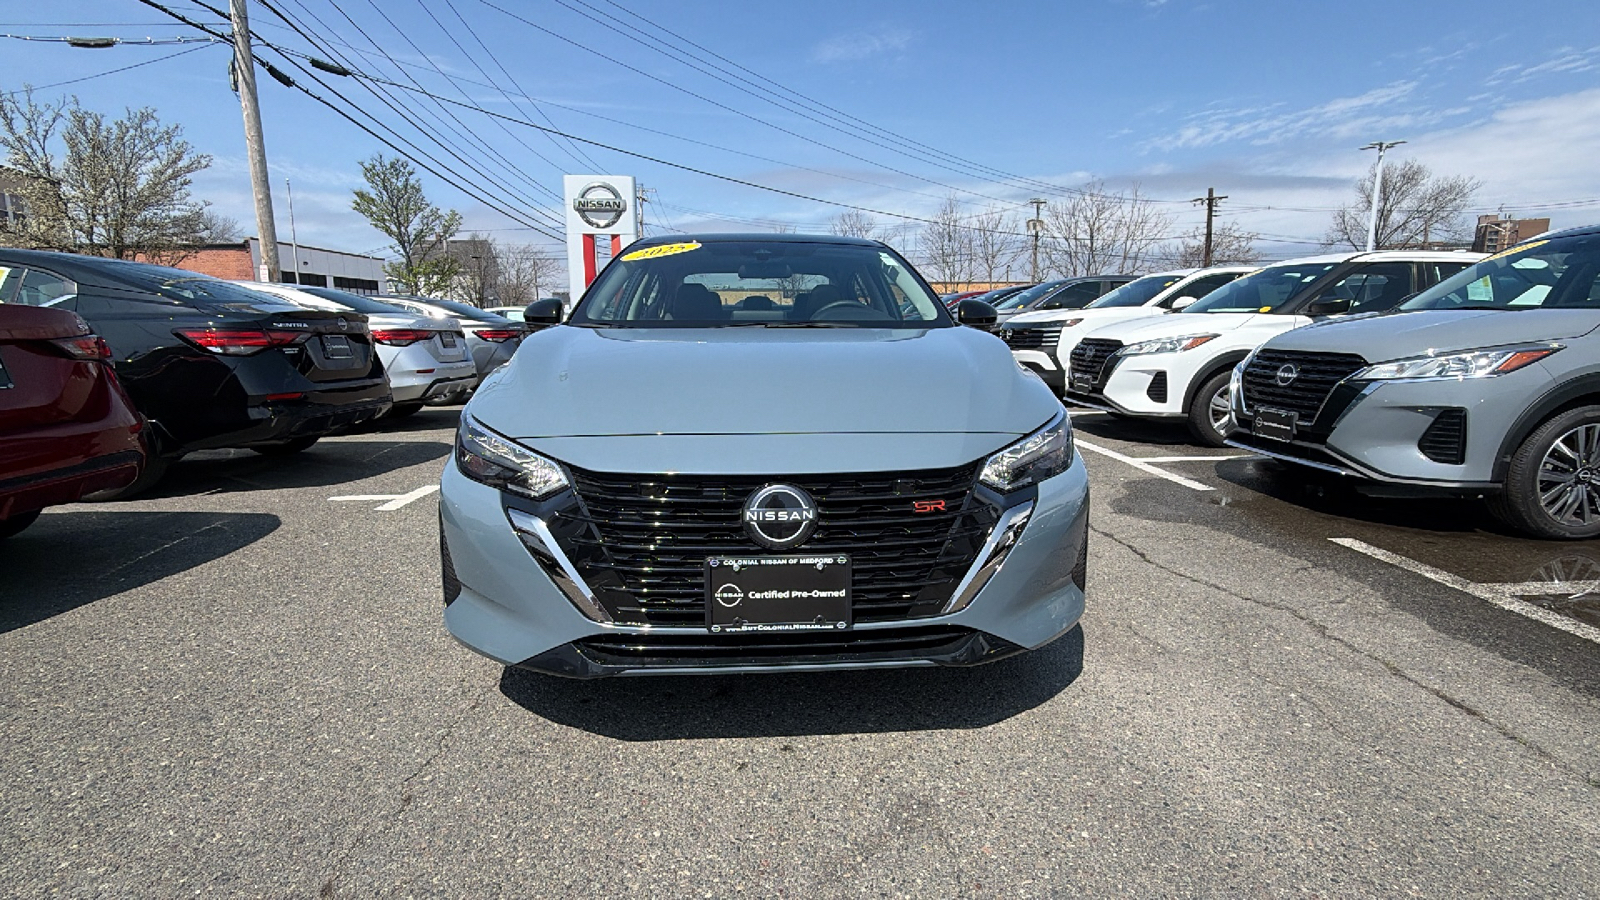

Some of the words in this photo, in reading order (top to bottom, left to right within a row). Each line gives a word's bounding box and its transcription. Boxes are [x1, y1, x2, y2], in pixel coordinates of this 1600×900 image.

[577, 200, 621, 209] NISSAN
[914, 499, 946, 513] SR
[746, 510, 813, 521] NISSAN
[748, 590, 790, 599] Certified
[791, 588, 846, 599] Pre-Owned
